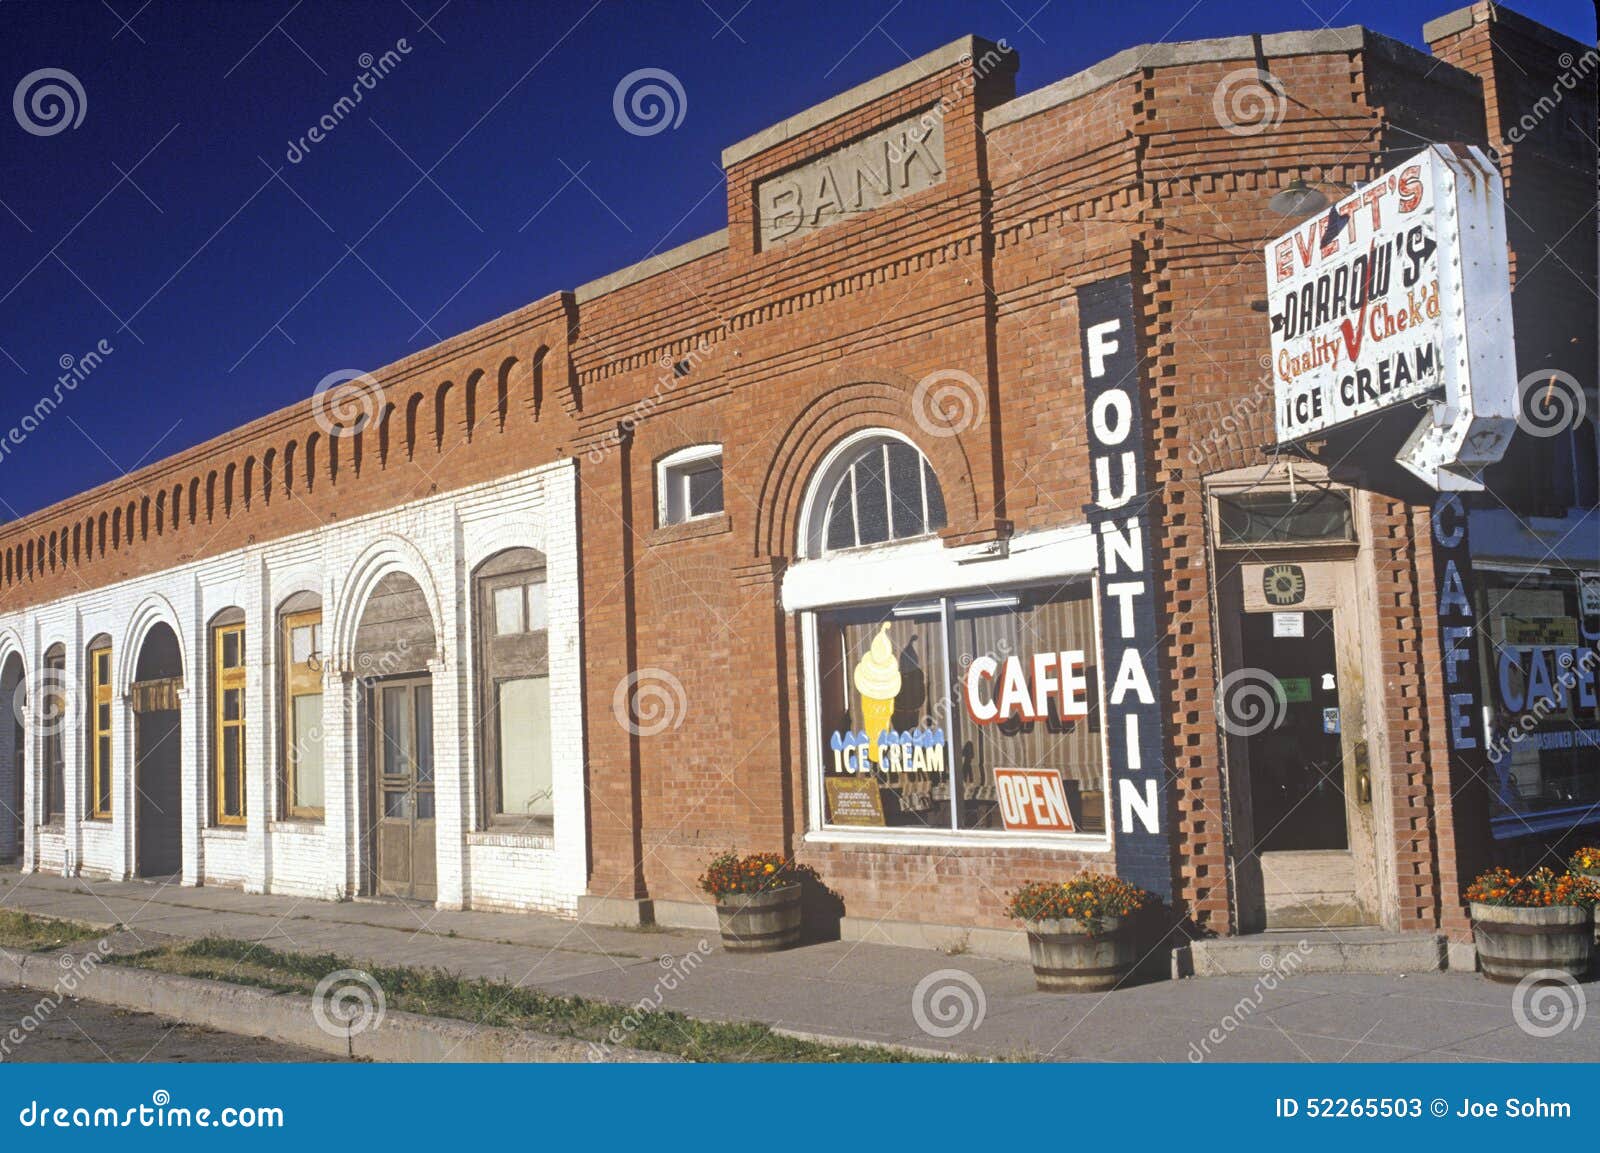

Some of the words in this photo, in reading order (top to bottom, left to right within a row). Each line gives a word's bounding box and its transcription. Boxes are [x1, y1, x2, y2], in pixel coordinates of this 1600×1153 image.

[766, 122, 942, 242] BANK
[1283, 224, 1426, 342] DARROW'S
[1277, 332, 1343, 384] Quality
[1369, 279, 1441, 343] Chek'd
[1285, 386, 1323, 428] ICE
[1340, 342, 1434, 407] CREAM
[1086, 318, 1160, 834] FOUNTAIN
[1432, 492, 1477, 750] CAFE
[964, 649, 1089, 726] CAFE
[1498, 646, 1598, 714] CAFE
[831, 730, 869, 773] ICE
[877, 727, 945, 773] CREAM
[999, 774, 1071, 827] OPEN
